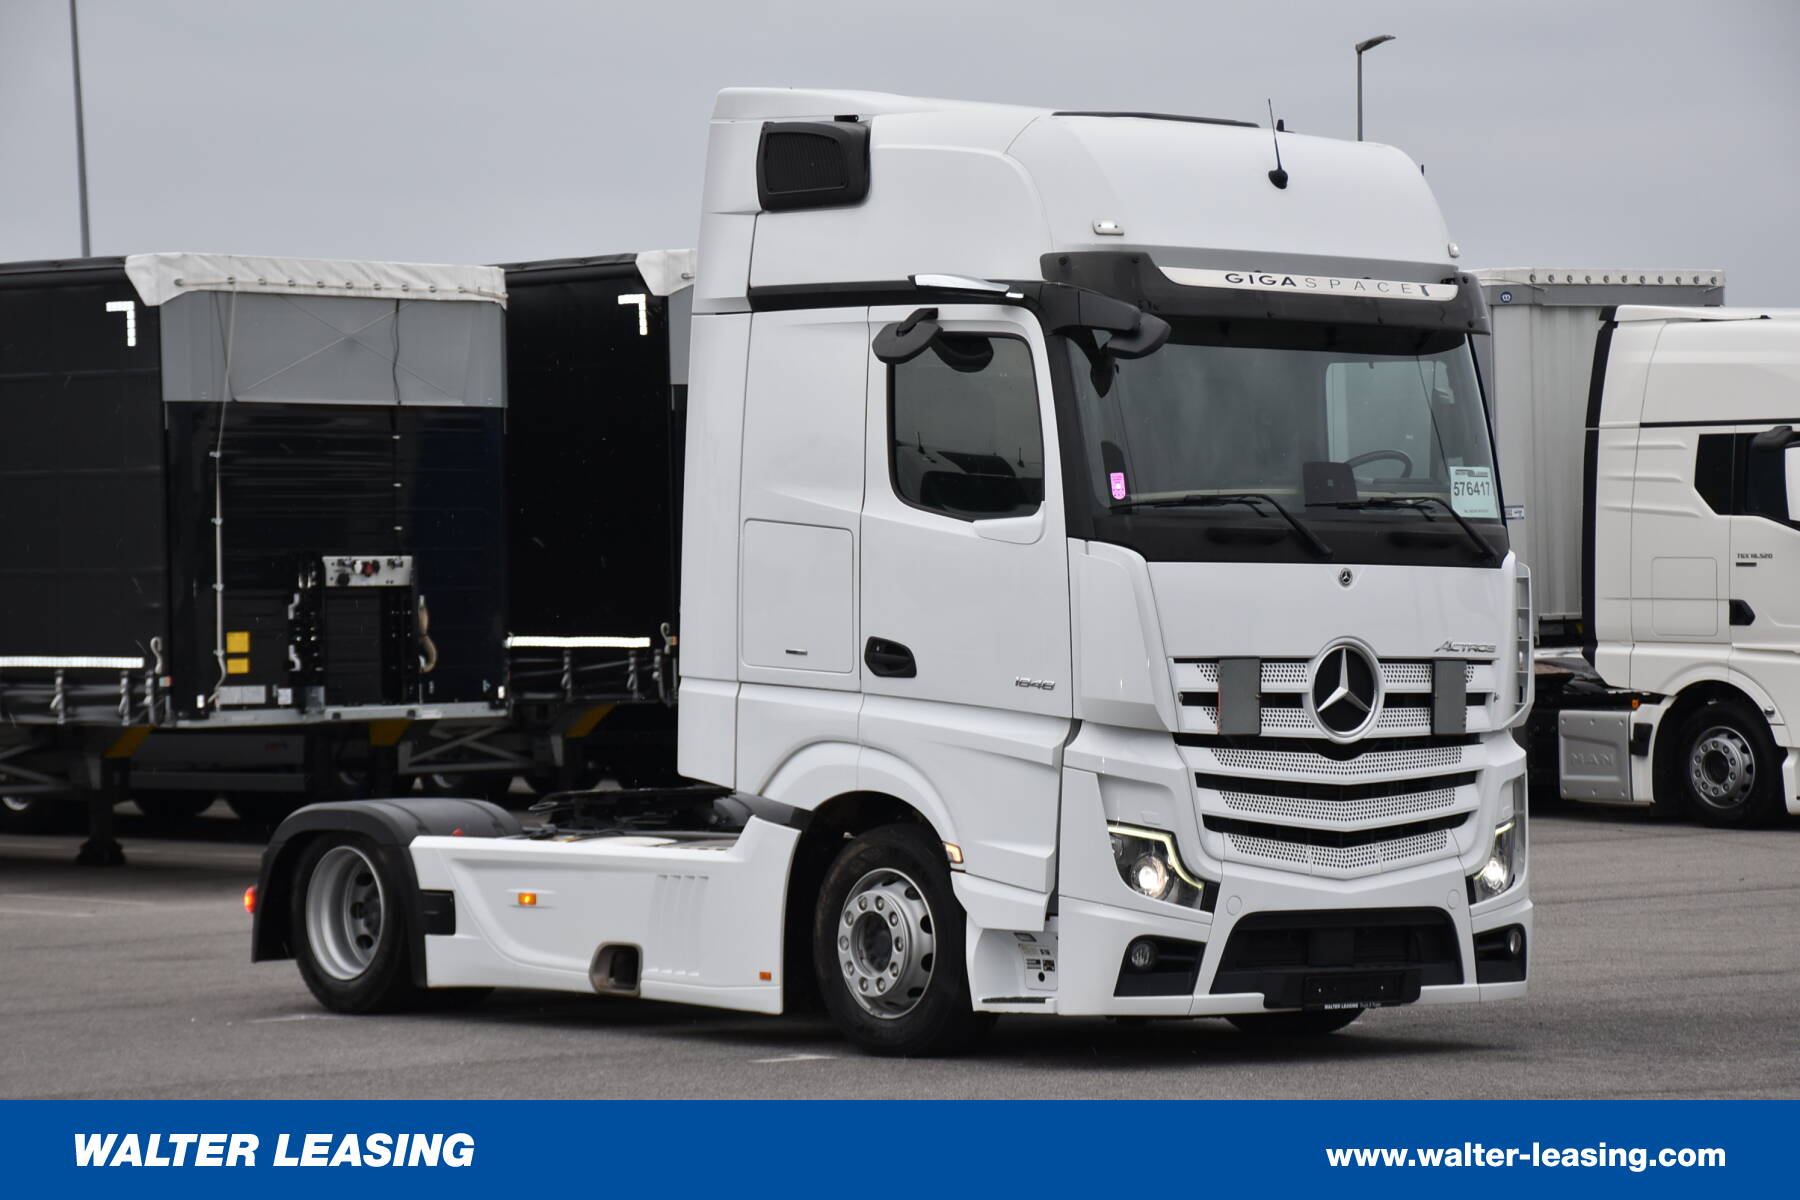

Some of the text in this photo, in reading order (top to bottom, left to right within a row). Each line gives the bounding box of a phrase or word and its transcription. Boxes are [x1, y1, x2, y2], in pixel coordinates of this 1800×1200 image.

[1453, 481, 1490, 496] 576417
[1015, 676, 1056, 691] 1848
[1569, 752, 1615, 768] MAN
